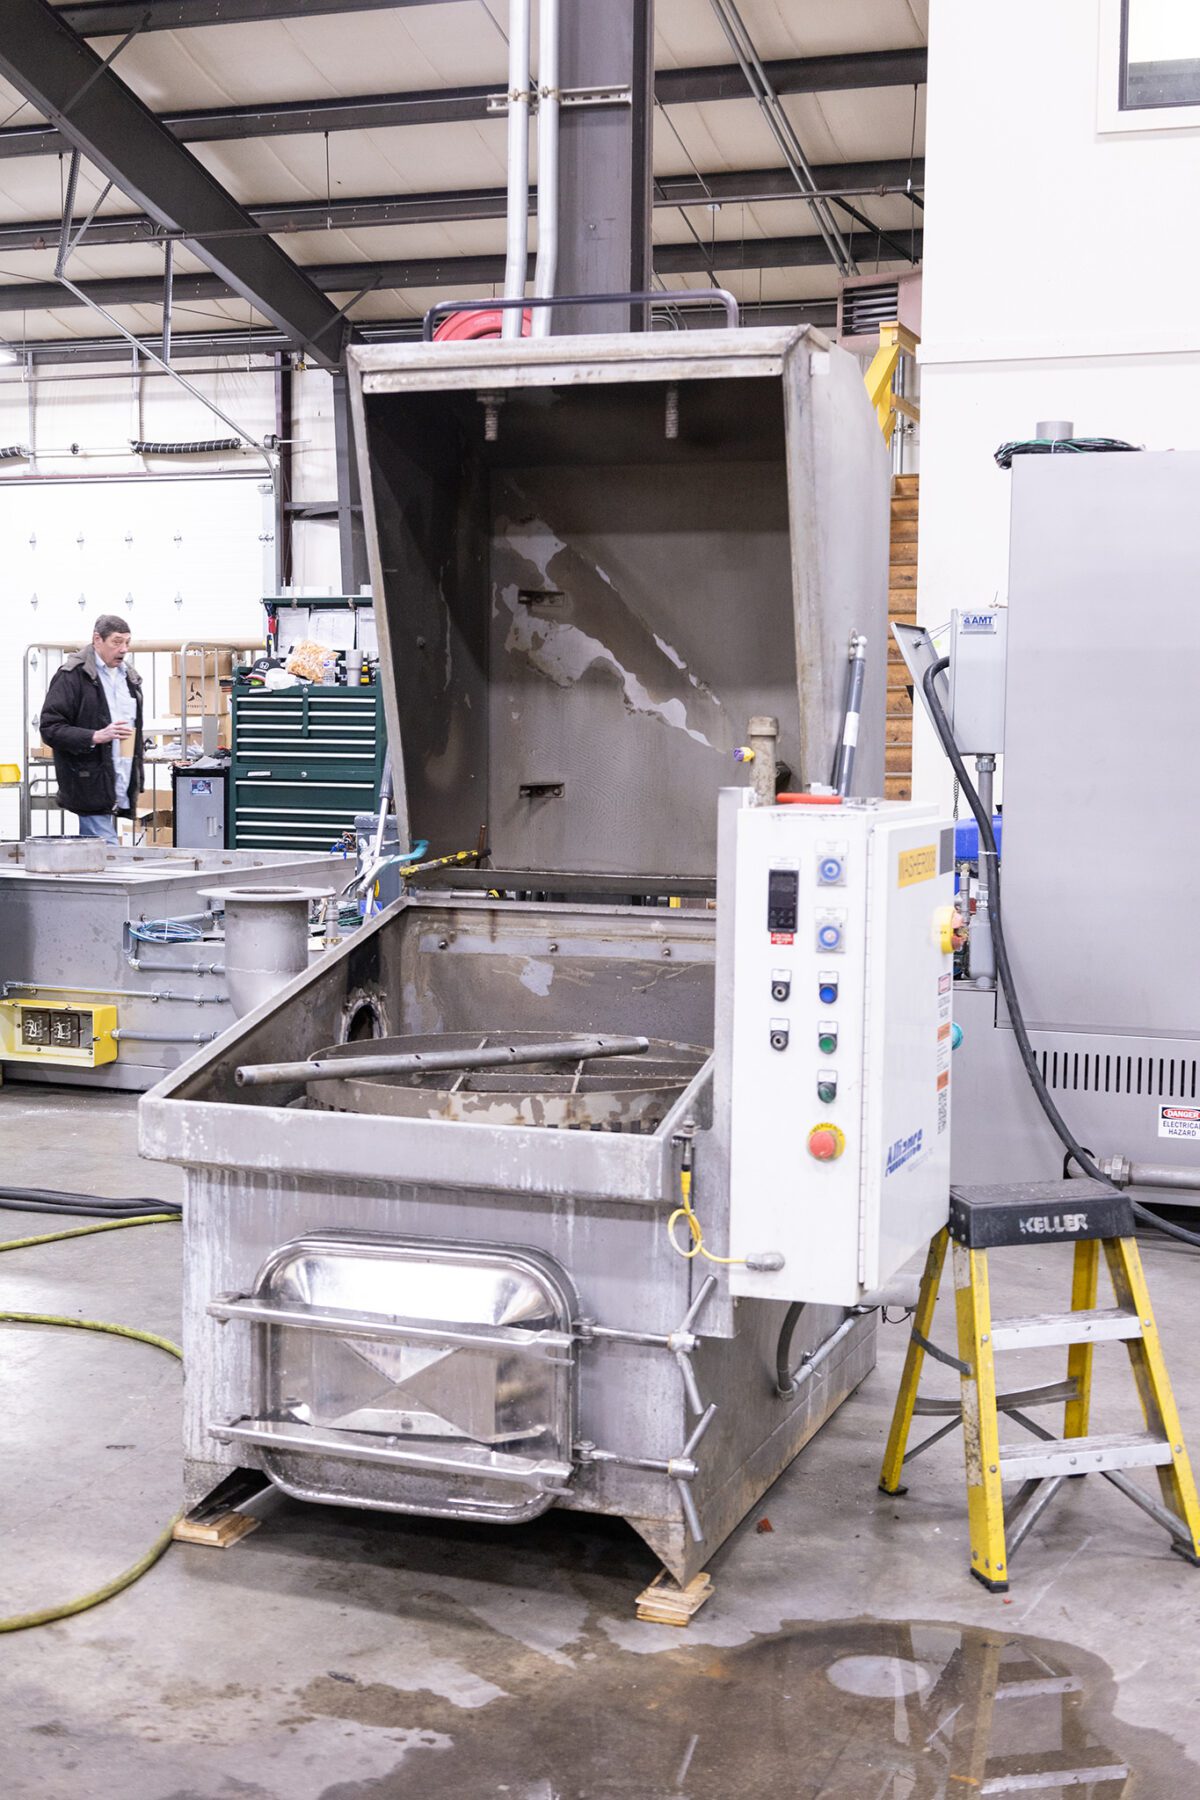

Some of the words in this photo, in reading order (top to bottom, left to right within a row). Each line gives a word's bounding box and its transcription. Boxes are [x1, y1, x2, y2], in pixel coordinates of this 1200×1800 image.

[972, 616, 993, 625] AMT
[1166, 1110, 1199, 1119] DANGER
[1168, 1128, 1197, 1137] HAZARD
[1019, 1213, 1089, 1235] KELLER
